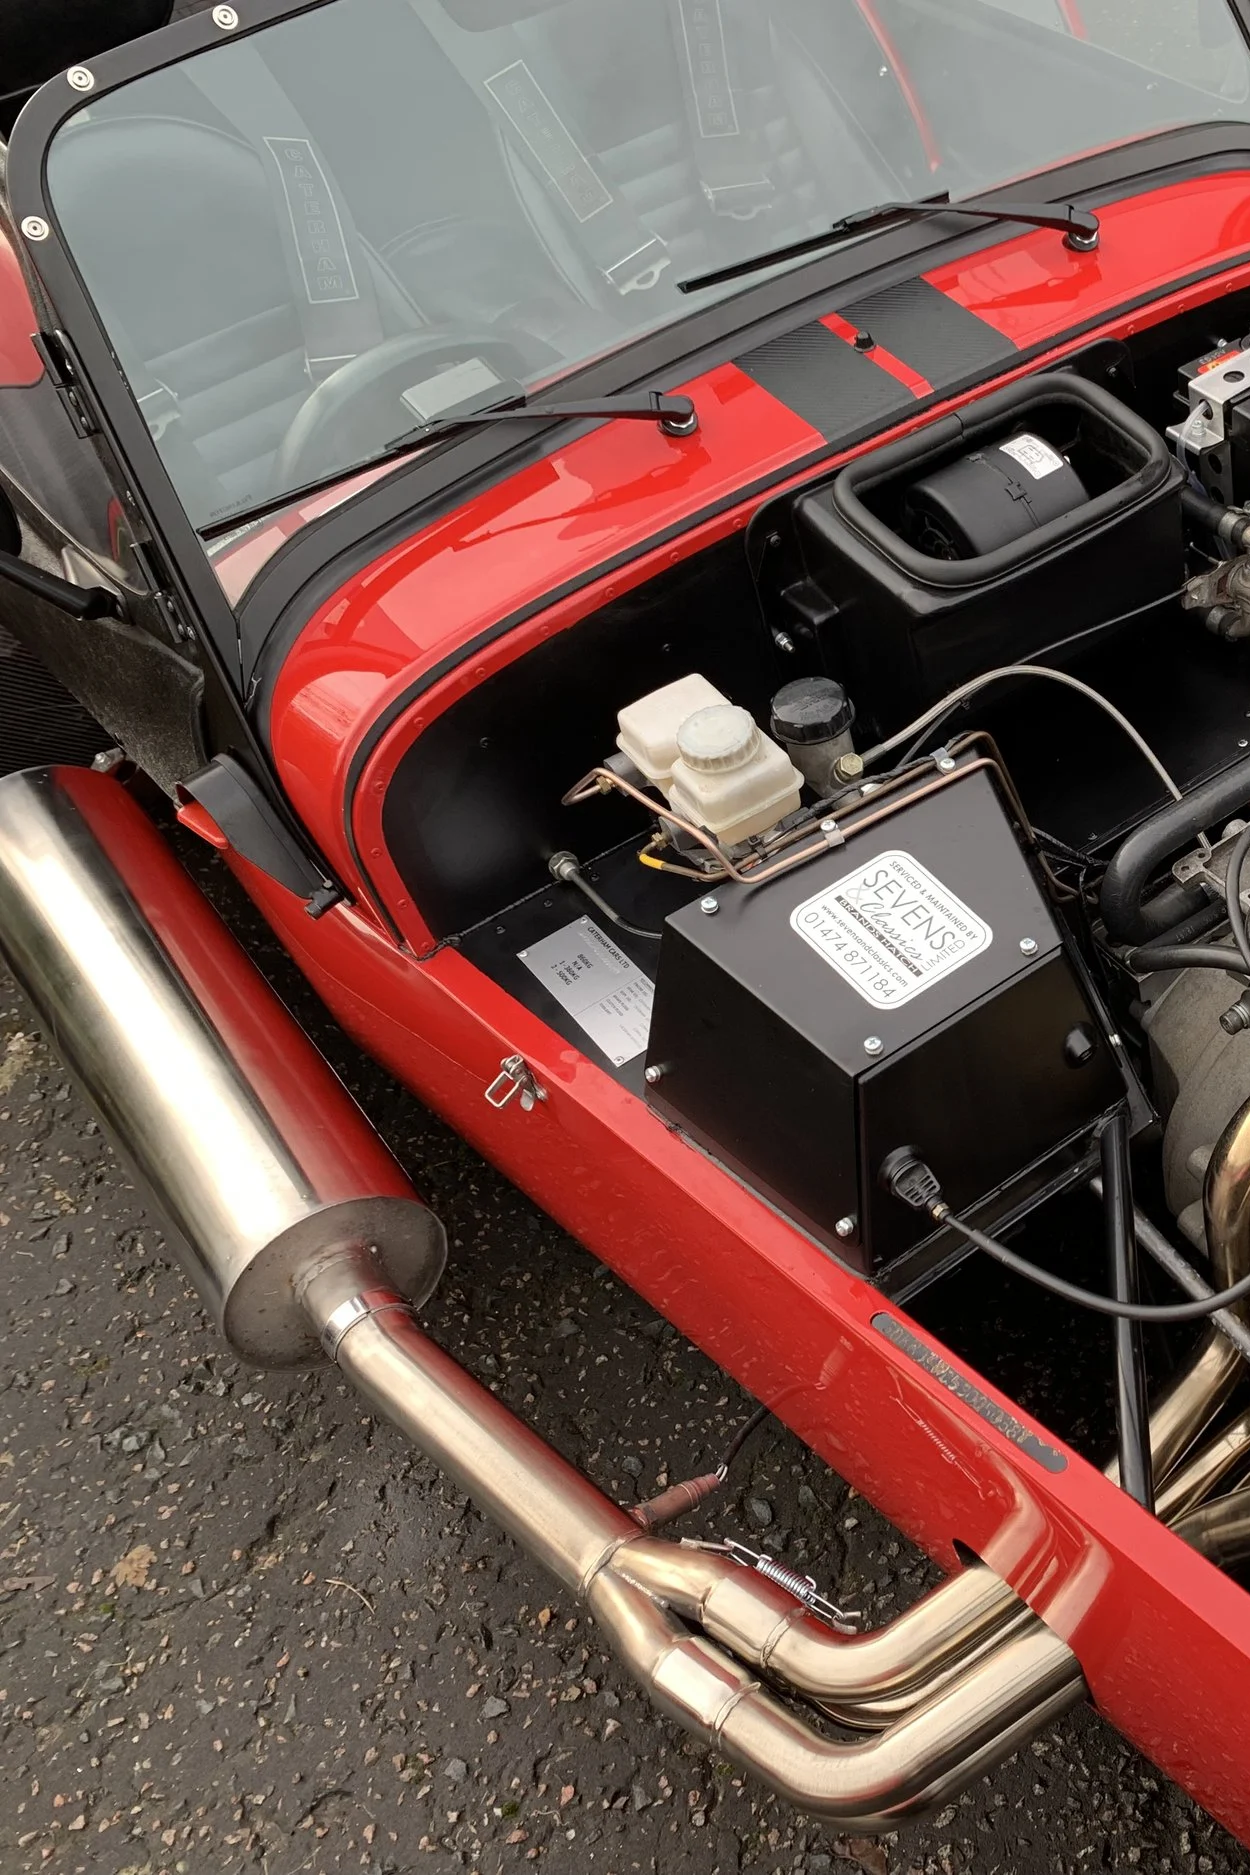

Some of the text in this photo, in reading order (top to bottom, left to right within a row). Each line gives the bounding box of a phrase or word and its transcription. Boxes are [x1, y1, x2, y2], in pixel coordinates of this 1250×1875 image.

[284, 148, 342, 290] CATERHAM
[839, 899, 919, 975] BRANDS HATCH
[859, 902, 924, 962] Classics
[863, 869, 956, 951] SEVENS
[889, 860, 979, 942] SERVICED & MAINTAINED BY
[588, 926, 630, 969] CATERHAM CARS LTD
[804, 912, 898, 998] 01474 871184
[821, 904, 909, 988] www.sevensandclassics.com
[920, 939, 966, 972] LIMITED
